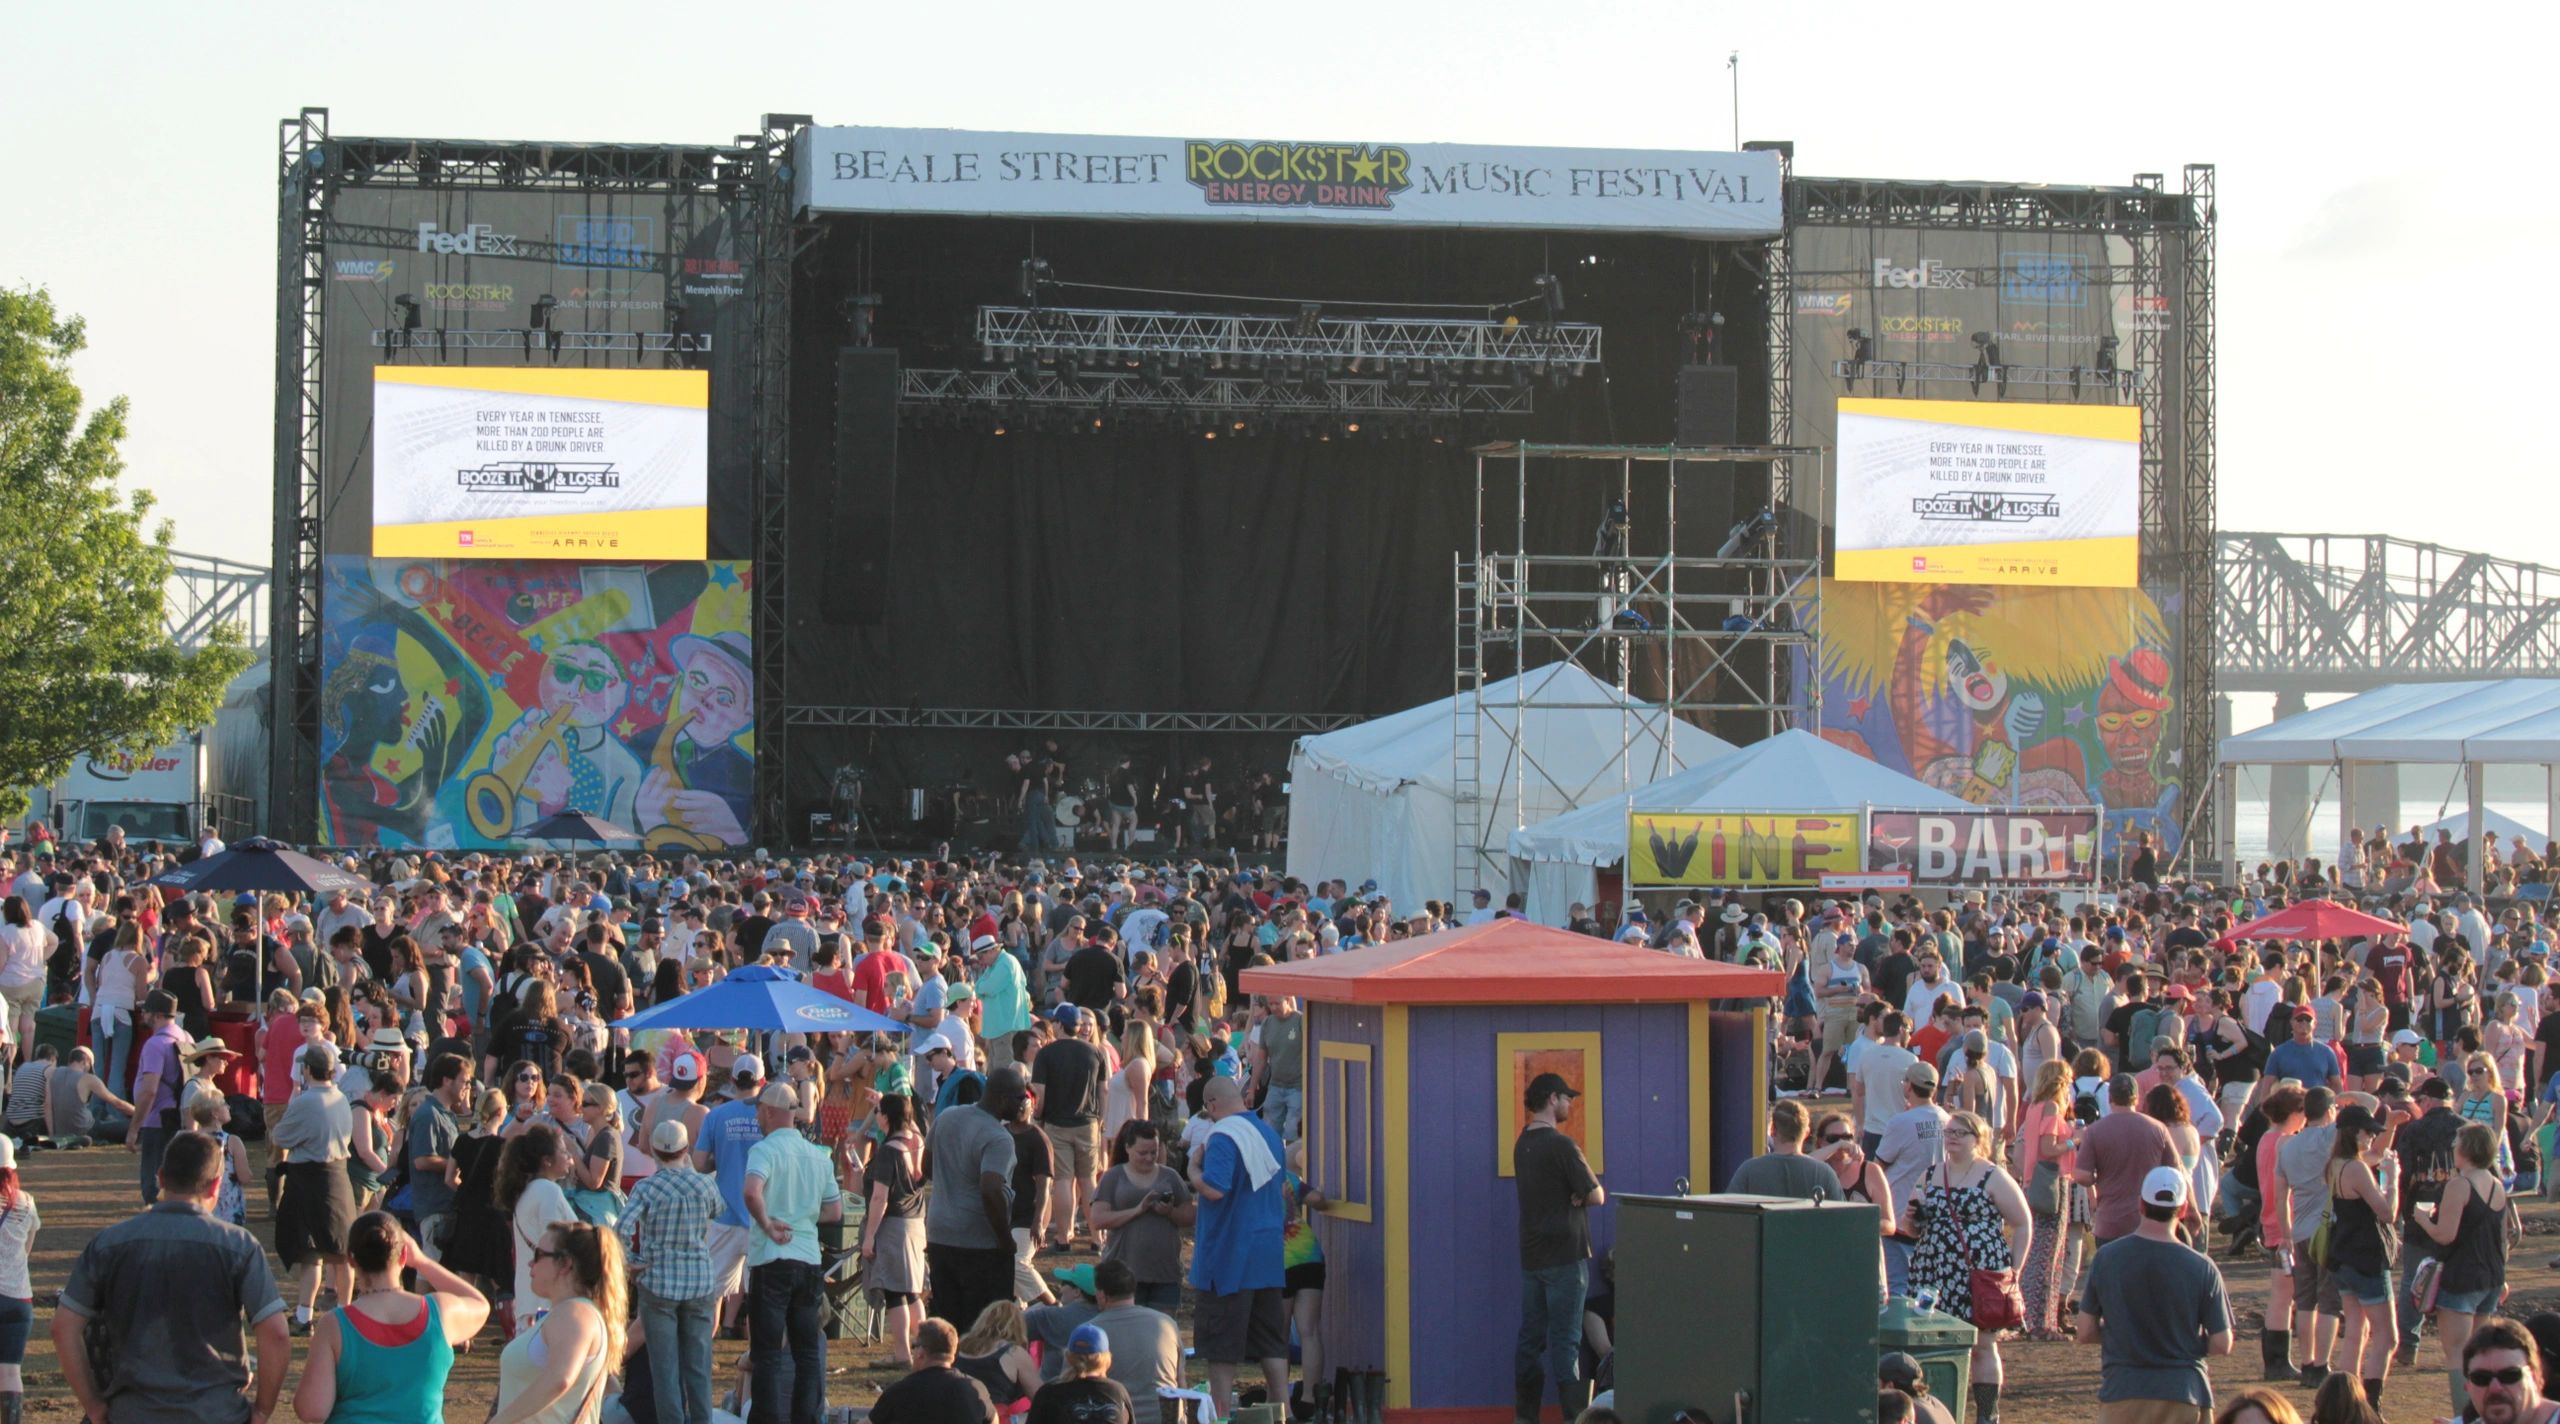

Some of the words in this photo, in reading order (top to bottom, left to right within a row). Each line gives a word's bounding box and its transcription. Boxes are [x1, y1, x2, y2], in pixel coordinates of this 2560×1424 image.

[831, 151, 981, 183] BEALE
[1000, 152, 1168, 184] STREET
[1420, 162, 1551, 198] MUSIC
[1568, 167, 1765, 204] FESTIVAL
[1208, 182, 1306, 202] ENERGY
[1317, 185, 1390, 205] DRINK
[418, 222, 517, 255] FedEx
[576, 222, 634, 242] BUD
[1874, 258, 1966, 289] FedEx
[476, 411, 506, 422] EVERY
[509, 411, 534, 423] YEAR
[537, 412, 546, 422] IN
[476, 426, 501, 436] MORE
[504, 426, 528, 437] THAN
[531, 427, 549, 437] 200
[551, 427, 584, 438] PEOPLE
[587, 427, 604, 438] ARE
[476, 440, 508, 451] KILLED
[511, 440, 523, 451] BY
[526, 441, 533, 451] A
[536, 441, 567, 452] DRUNK
[1930, 442, 1958, 453] EVERY
[1960, 442, 1982, 454] YEAR
[1985, 443, 1993, 454] IN
[1930, 456, 1952, 467] MORE
[1955, 457, 1977, 468] THAN
[1979, 458, 1996, 468] 200
[1998, 459, 2028, 469] PEOPLE
[2031, 459, 2046, 470] ARE
[460, 471, 506, 484] BOOZE
[510, 472, 523, 484] IT
[556, 473, 566, 485] &
[569, 473, 602, 486] LOSE
[605, 473, 618, 486] IT
[1930, 470, 1959, 481] KILLED
[1962, 471, 1973, 482] BY
[1975, 472, 1981, 482] A
[1984, 472, 2012, 483] DRUNK
[1915, 500, 1956, 513] BOOZE
[1959, 501, 1972, 513] IT
[2002, 502, 2011, 515] &
[2014, 503, 2044, 516] LOSE
[2047, 503, 2060, 516] IT
[553, 539, 618, 547] ARRVE
[516, 591, 573, 609] CAFE
[453, 613, 524, 672] BEALE
[1646, 818, 1842, 880] WINE
[1918, 817, 2046, 880] BAR
